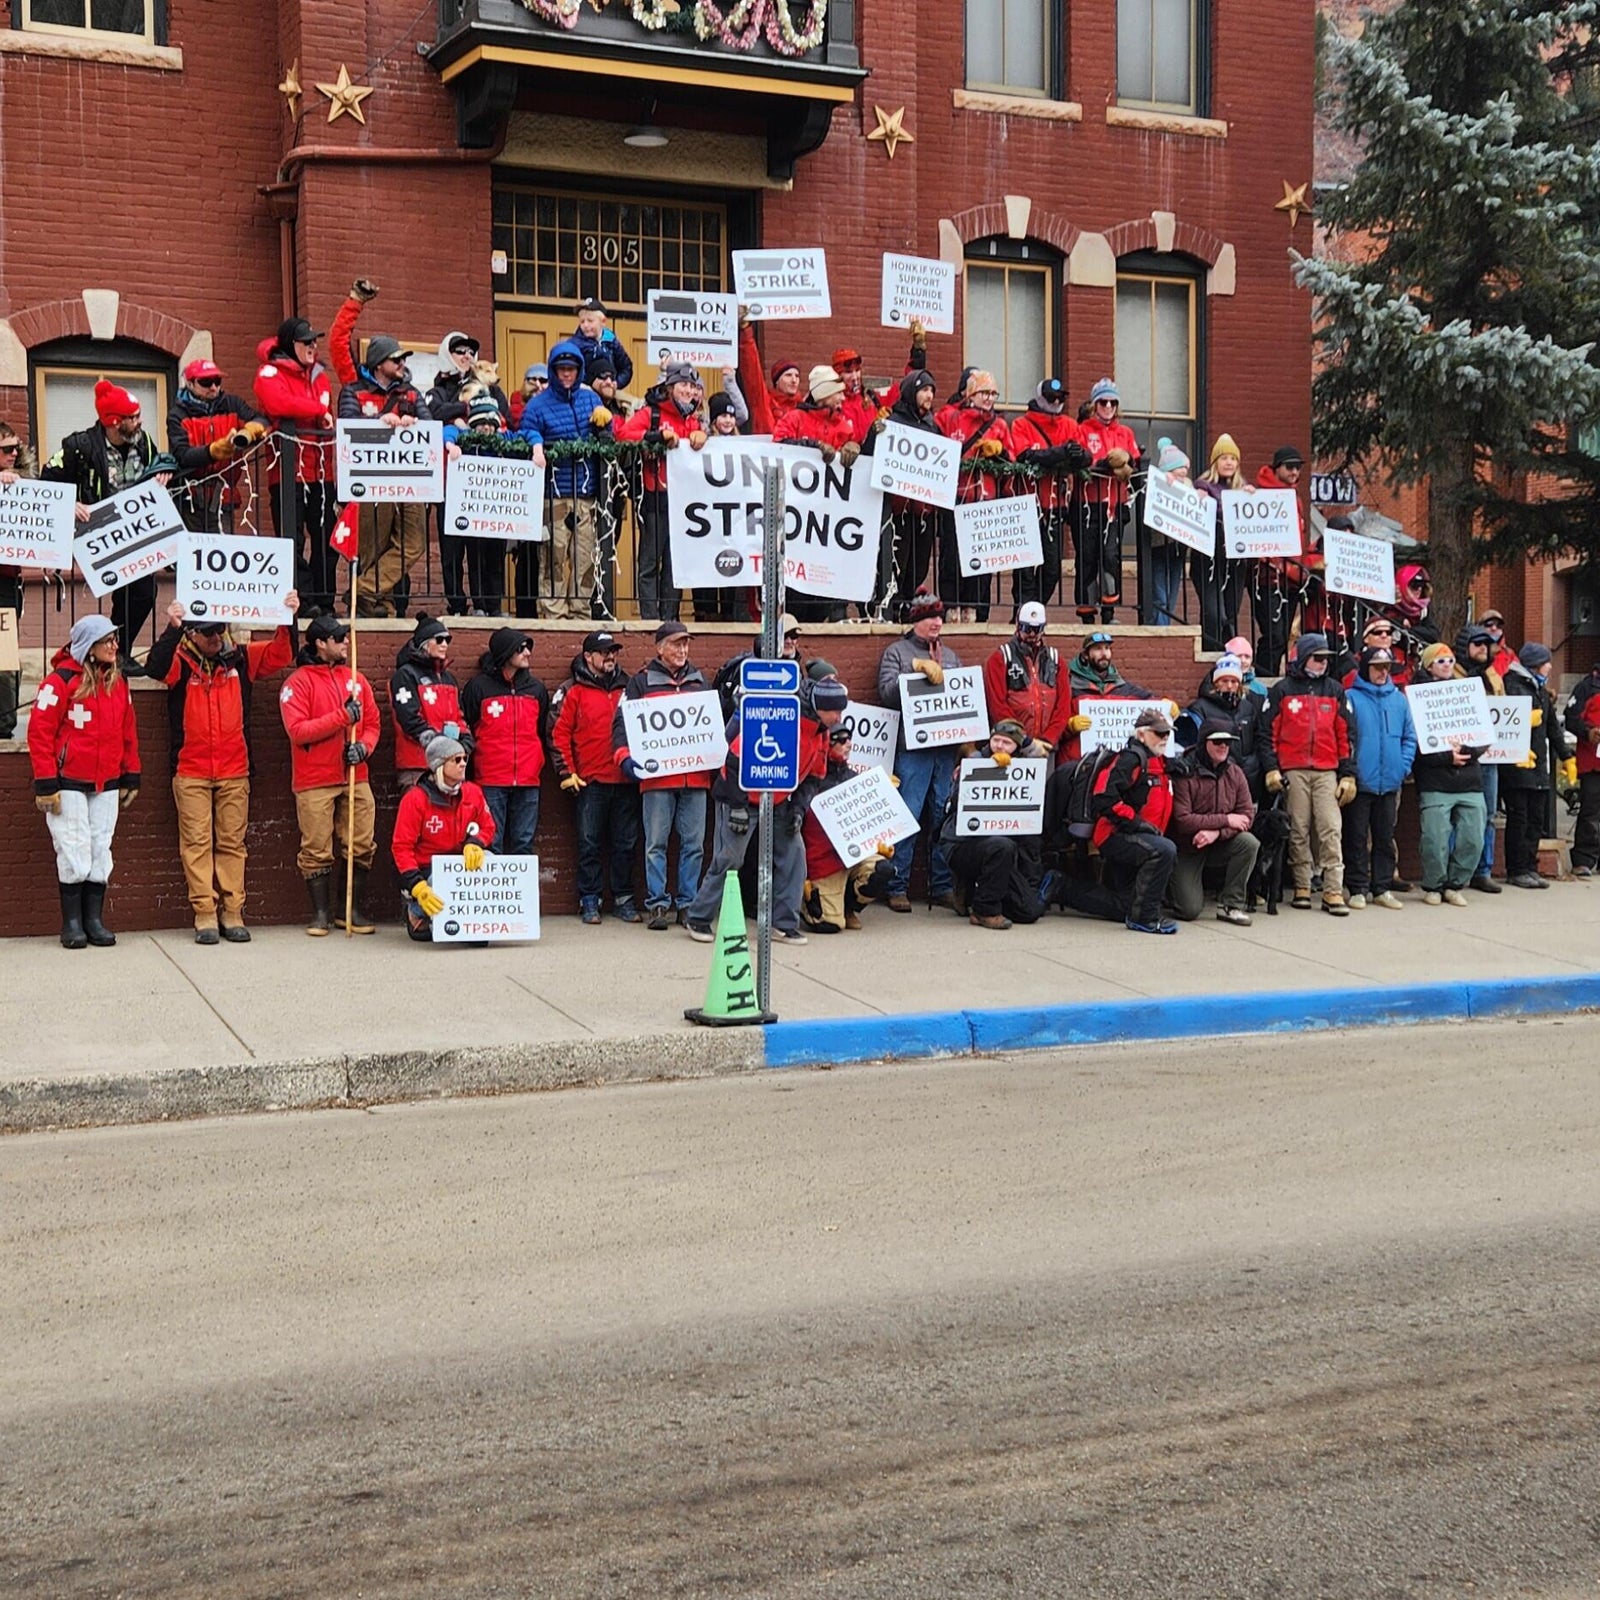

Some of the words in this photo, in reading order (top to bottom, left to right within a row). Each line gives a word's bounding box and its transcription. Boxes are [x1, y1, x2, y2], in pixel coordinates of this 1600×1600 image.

[583, 235, 639, 265] 305
[787, 257, 815, 270] ON
[891, 260, 918, 273] HONK
[920, 265, 927, 274] IF
[929, 266, 948, 277] YOU
[747, 274, 815, 288] STRIKE,
[899, 274, 940, 288] SUPPORT
[895, 285, 942, 299] TELLURIDE
[701, 301, 727, 315] ON
[766, 304, 806, 314] TPSPA
[894, 296, 908, 307] SKI
[910, 299, 944, 312] PATROL
[660, 318, 726, 336] STRIKE,
[674, 351, 714, 362] TPSPA
[400, 430, 430, 444] ON
[352, 450, 428, 467] STRIKE,
[887, 435, 949, 468] 100%
[458, 463, 494, 474] HONK
[496, 466, 507, 475] IF
[511, 466, 535, 477] YOU
[884, 458, 949, 483] SOLIDARITY
[468, 477, 525, 490] SUPPORT
[896, 480, 932, 498] TPSPA
[16, 487, 29, 496] IF
[33, 488, 63, 500] YOU
[369, 486, 415, 496] TPSPA
[463, 489, 528, 503] TELLURIDE
[0, 500, 50, 512] PPORT
[124, 491, 157, 514] ON
[461, 503, 479, 512] SKI
[483, 505, 529, 516] PATROL
[1187, 493, 1208, 512] ON
[963, 508, 992, 520] HONK
[995, 506, 1004, 515] IF
[1006, 502, 1028, 513] YOU
[1156, 493, 1206, 527] STRIKE,
[1232, 501, 1288, 520] 100%
[0, 514, 54, 528] LURIDE
[472, 521, 514, 533] TPSPA
[973, 515, 1021, 530] SUPPORT
[86, 513, 166, 555] STRIKE,
[971, 525, 1026, 542] TELLURIDE
[1165, 521, 1196, 542] TPSPA
[1234, 524, 1289, 535] SOLIDARITY
[971, 544, 988, 554] SKI
[990, 537, 1029, 551] PATROL
[1248, 543, 1281, 553] TPSPA
[1331, 535, 1358, 549] HONK
[1359, 541, 1366, 550] IF
[1367, 542, 1386, 554] YOU
[983, 553, 1020, 568] TPSPA
[1339, 547, 1379, 561] SUPPORT
[120, 551, 167, 578] TPSPA
[192, 549, 279, 575] 100%
[749, 556, 807, 580] TPA
[1336, 557, 1383, 573] TELLURIDE
[1336, 566, 1350, 577] SKI
[1352, 570, 1384, 583] PATROL
[192, 580, 279, 594] SOLIDARITY
[1346, 582, 1376, 594] TPSPA
[211, 605, 261, 617] TPSPA
[950, 677, 973, 690] ON
[1415, 688, 1444, 699] HONK
[1446, 686, 1454, 694] IF
[1455, 683, 1476, 693] YOU
[914, 695, 975, 713] STRIKE,
[1426, 696, 1471, 709] SUPPORT
[745, 707, 796, 721] HANDICAPPED
[1089, 707, 1124, 715] HONK
[1126, 707, 1136, 715] IF
[1425, 706, 1477, 721] TELLURIDE
[636, 705, 711, 734] 100%
[1100, 718, 1137, 727] SUPPO
[1426, 722, 1443, 732] SKI
[1444, 718, 1481, 730] PATROL
[843, 715, 888, 741] 00%
[930, 729, 967, 741] TPSPA
[641, 732, 715, 751] SOLIDARITY
[853, 743, 887, 757] DARITY
[661, 755, 705, 770] TPSPA
[750, 766, 789, 779] PARKING
[1011, 768, 1036, 781] ON
[819, 789, 850, 810] HONK
[849, 785, 859, 795] IF
[860, 774, 880, 790] YOU
[971, 786, 1033, 801] STRIKE,
[835, 789, 879, 817] SUPPORT
[837, 798, 890, 829] TELLURIDE
[843, 827, 860, 841] SKI
[860, 809, 898, 833] PATROL
[983, 820, 1020, 830] TPSPA
[486, 863, 498, 872] IF
[500, 862, 528, 872] YOU
[456, 877, 517, 887] SUPPORT
[451, 891, 522, 900] TELLURIDE
[449, 905, 469, 915] SKI
[473, 904, 524, 915] PATROL
[463, 923, 509, 934] TPSPA
